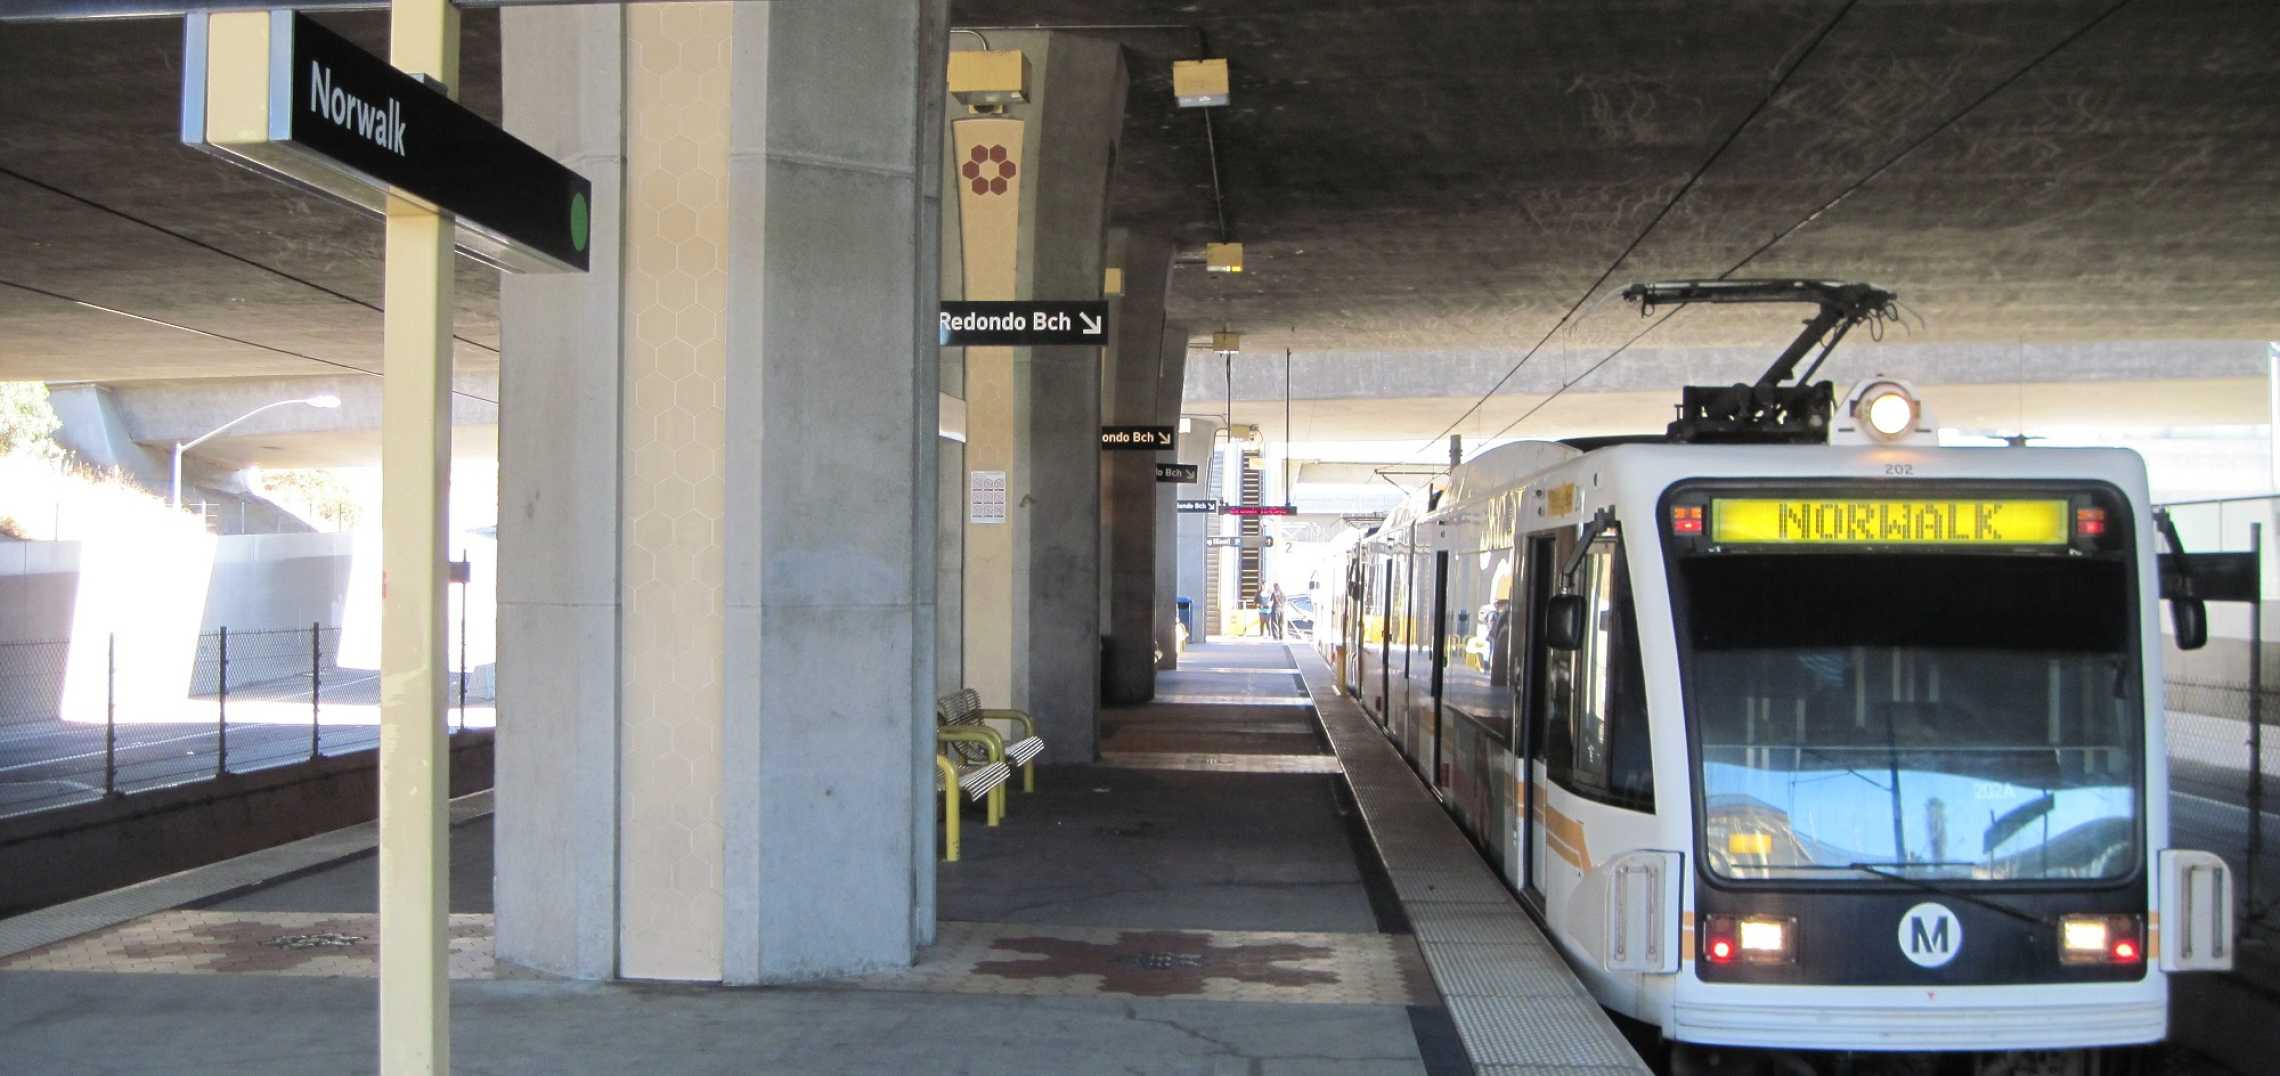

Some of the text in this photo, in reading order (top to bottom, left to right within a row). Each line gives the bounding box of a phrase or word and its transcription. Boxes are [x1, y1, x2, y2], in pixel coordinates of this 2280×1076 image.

[311, 60, 406, 157] Norwalk
[940, 312, 1071, 331] Redondo Bch
[1133, 432, 1154, 443] Bch
[1165, 468, 1182, 477] Bch
[1885, 464, 1914, 475] 202
[1778, 503, 2003, 539] NORWALK
[1912, 916, 1948, 953] M
